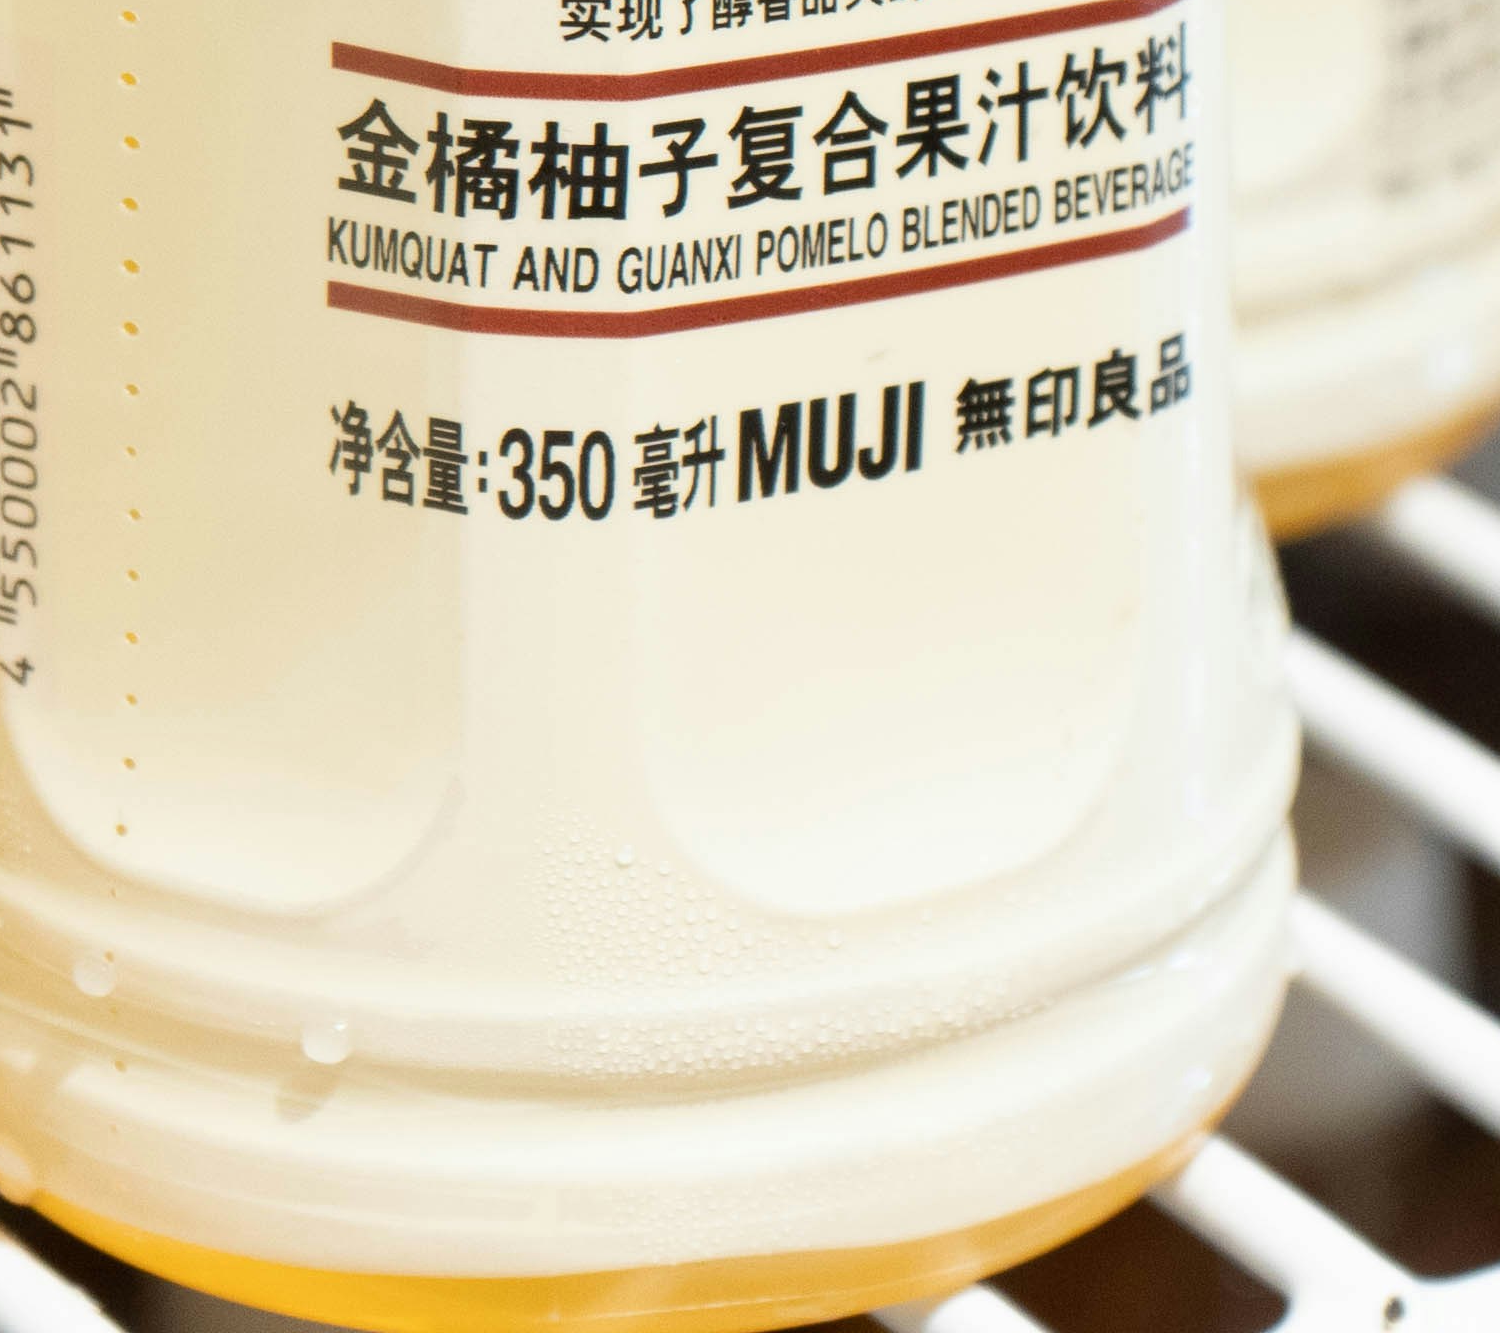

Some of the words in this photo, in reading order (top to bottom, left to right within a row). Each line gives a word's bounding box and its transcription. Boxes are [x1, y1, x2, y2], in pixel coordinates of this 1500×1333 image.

[337, 20, 1191, 221] 金橘柚子复合果汁饮料
[327, 215, 499, 288] KUMQUAT
[513, 245, 599, 293] AND
[616, 234, 742, 294] GUANXI
[756, 211, 888, 276] POMELO
[902, 185, 1041, 253] BLENDED
[1053, 141, 1194, 224] BEVERAGE
[737, 381, 927, 505] MUJI
[954, 333, 1193, 455] 無印良品
